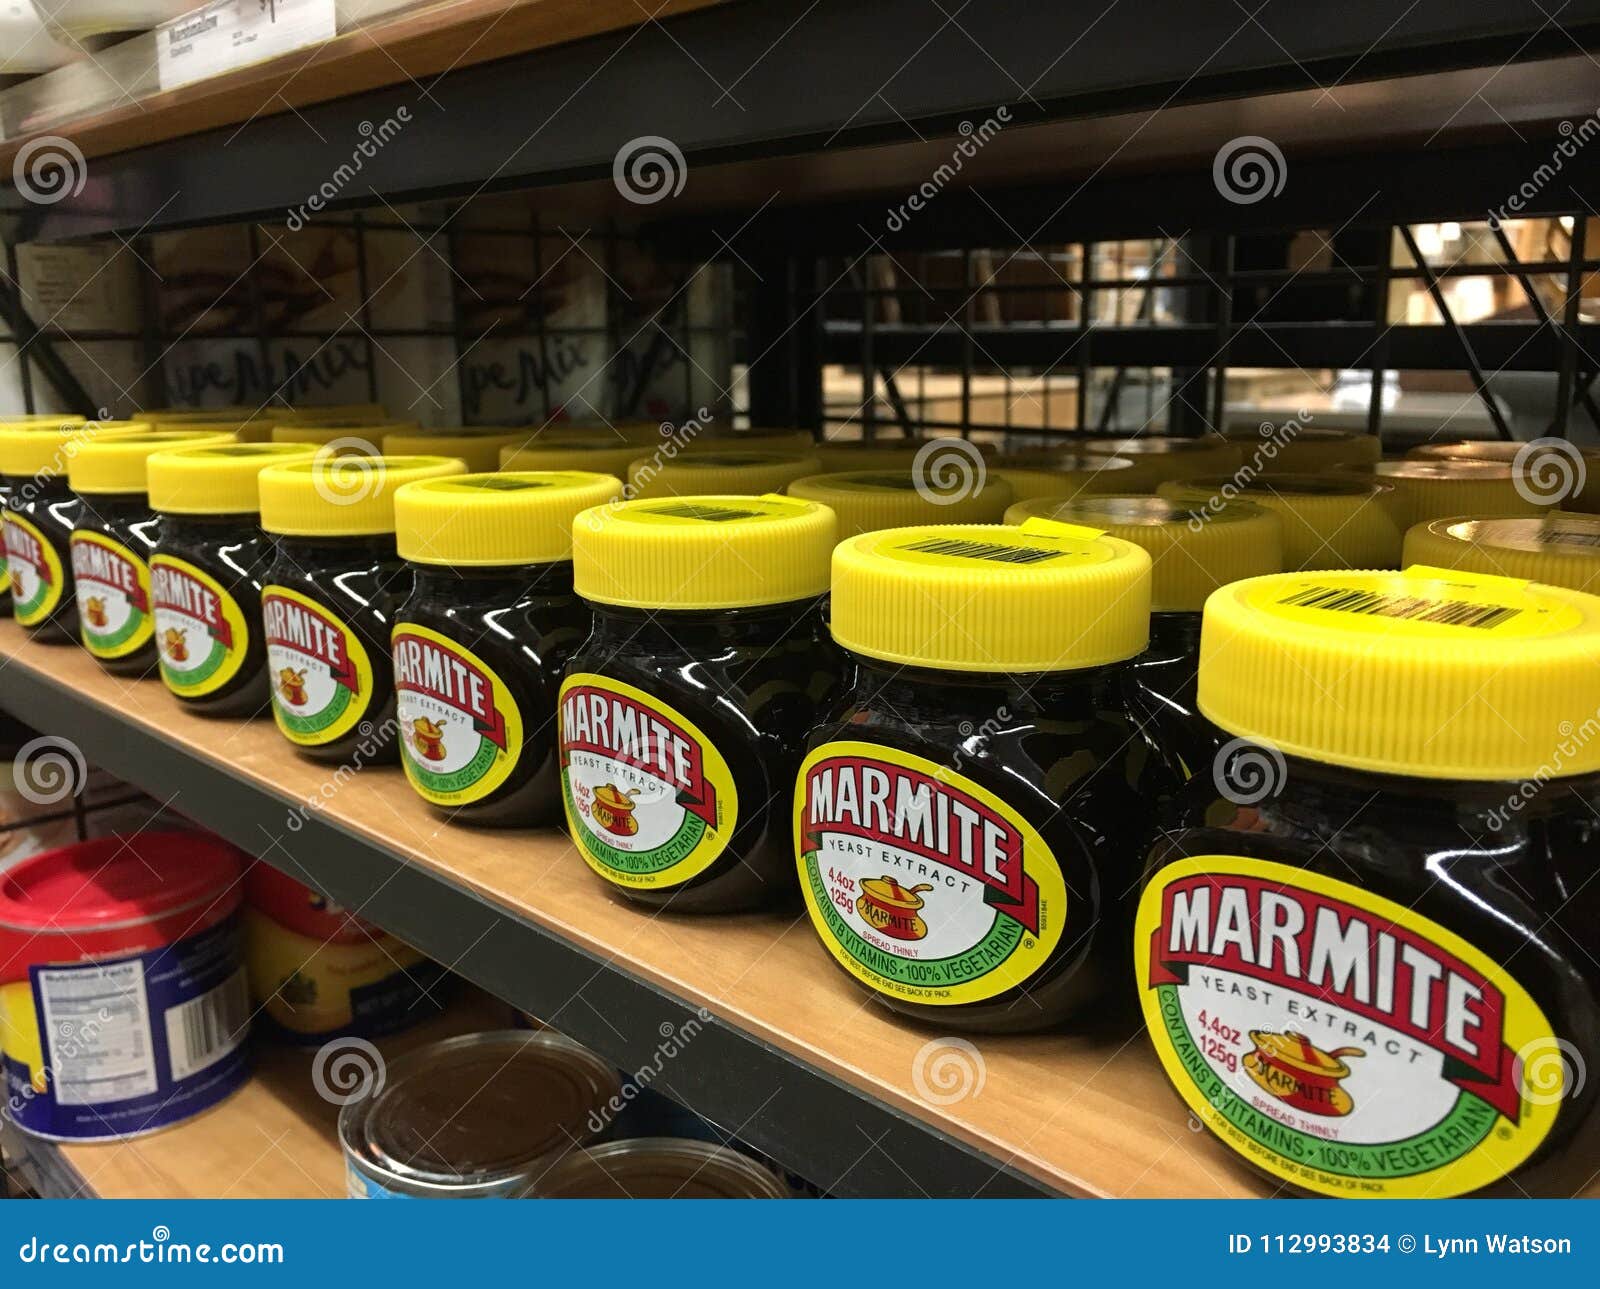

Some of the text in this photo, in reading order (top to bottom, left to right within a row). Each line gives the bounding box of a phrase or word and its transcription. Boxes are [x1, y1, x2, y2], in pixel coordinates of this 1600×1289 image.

[264, 599, 341, 665] ARMITE
[394, 639, 487, 717] ARMITE
[563, 693, 693, 788] MARMITE
[605, 762, 667, 797] EXTRACT
[650, 816, 702, 869] VEGETARIAN
[810, 766, 1009, 886] MARMITE
[828, 838, 972, 894] YEAST EXTRACT
[828, 866, 856, 892] 4.4oz
[806, 856, 838, 927] CONTAINS
[845, 933, 898, 976] VITAMINS
[906, 964, 941, 981] 100%
[941, 918, 1020, 982] VEGETARIAN
[830, 887, 854, 915] 125g
[860, 899, 919, 932] MARMITE
[862, 930, 919, 958] SPREAD THINLY
[1168, 886, 1485, 1058] MARMITE
[1198, 1008, 1242, 1046] 4.4oz
[1200, 975, 1424, 1065] YEAST EXTRACT
[1200, 1034, 1238, 1074] 125g
[1161, 989, 1211, 1084] CONTAINS
[1220, 1092, 1305, 1158] VITAMINS
[1319, 1146, 1371, 1172] 100%
[1374, 1099, 1494, 1173] VEGETARIAN
[1249, 1055, 1339, 1107] MARMITE
[1252, 1096, 1340, 1140] SPREAD THINLY
